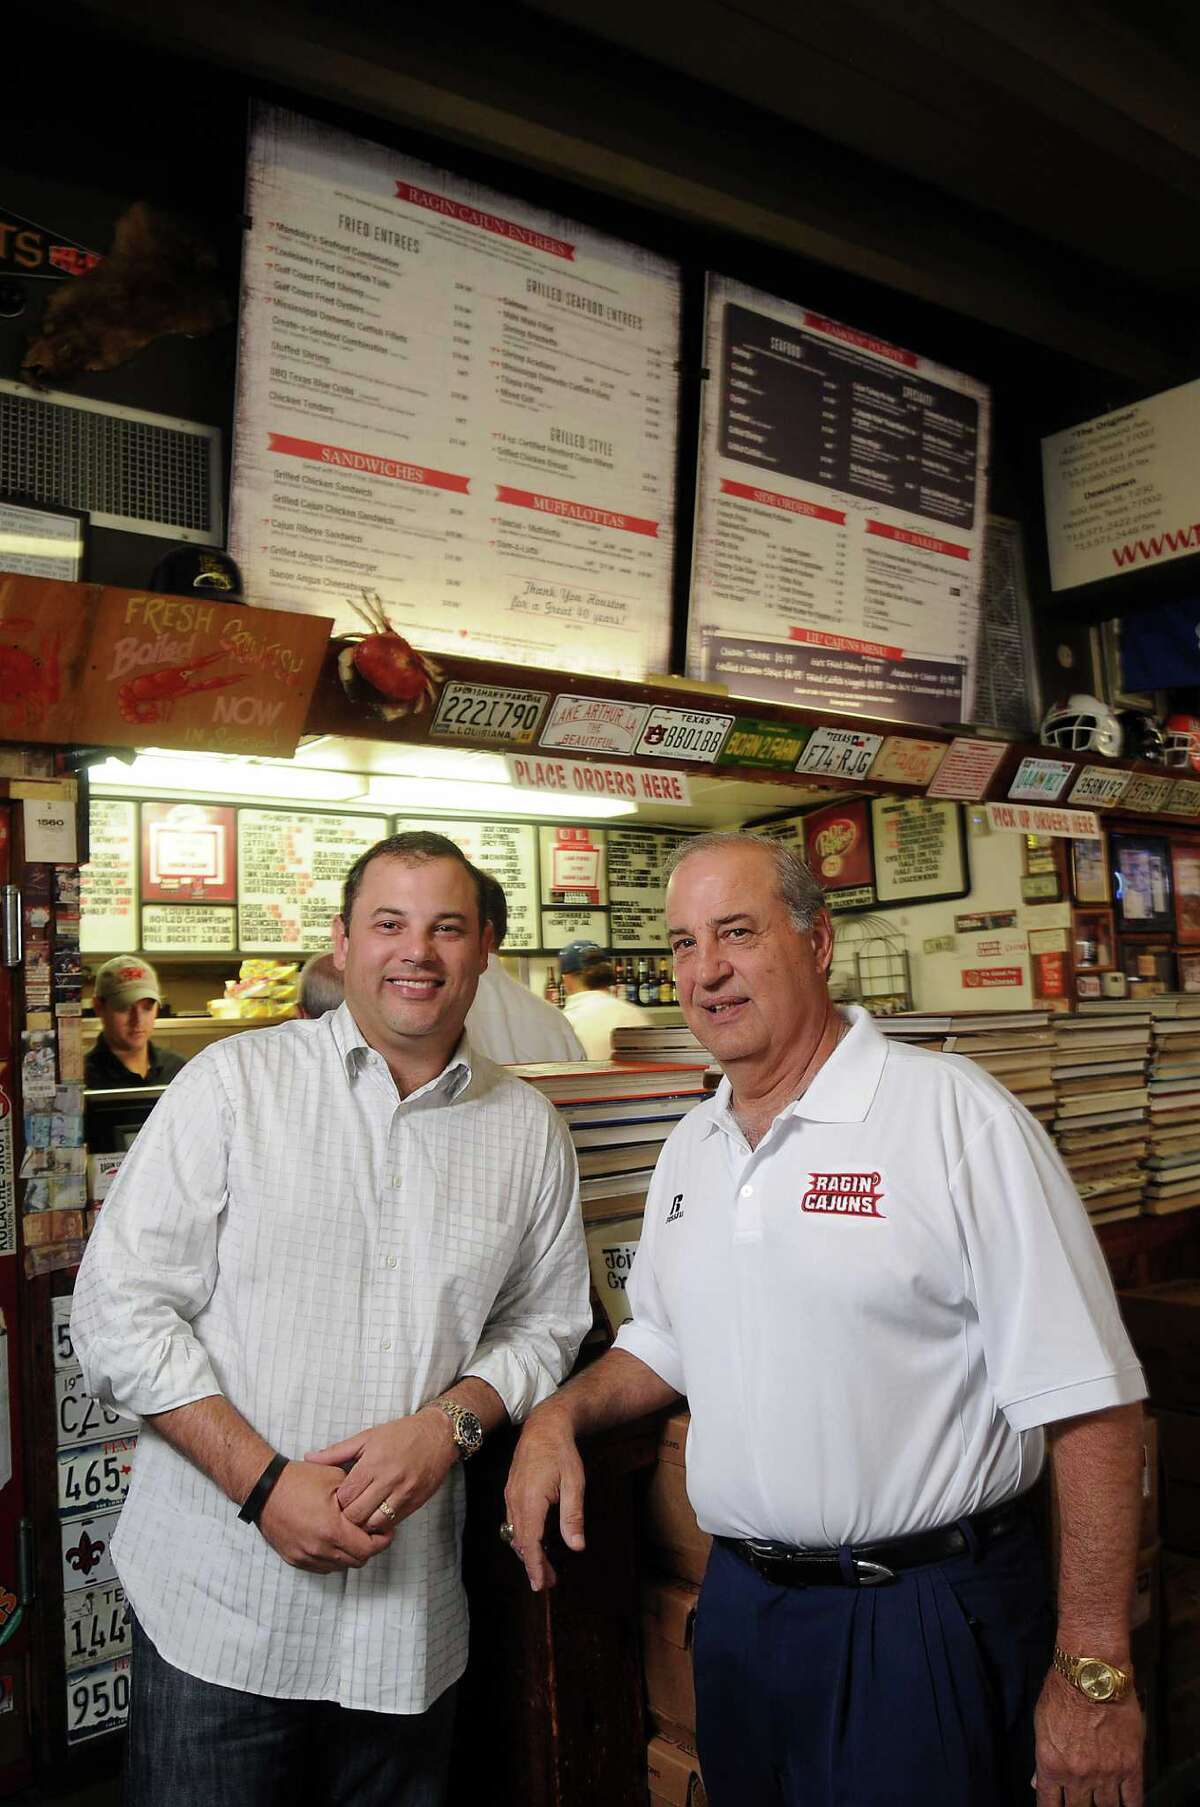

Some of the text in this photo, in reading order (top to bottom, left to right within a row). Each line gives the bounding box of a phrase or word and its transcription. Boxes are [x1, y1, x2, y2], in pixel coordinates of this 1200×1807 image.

[338, 214, 421, 254] FRIED ENTREES
[408, 188, 565, 254] RAGIN CAJUN ENTREES
[315, 258, 336, 272] Fried
[315, 276, 336, 289] Fried
[315, 294, 336, 306] Fried
[526, 277, 643, 331] GRILLED SEAFOOD ENTREES
[289, 371, 312, 386] Texas
[269, 391, 302, 406] Chicken
[549, 426, 614, 457] GRILLED STYLE
[321, 447, 425, 483] SANDWICHES
[273, 468, 374, 497] Grilled Chicken Sandwich
[272, 493, 396, 525] Grilled Cajun Chicken Sandwich
[533, 496, 626, 528] MUFFALOTTAS
[270, 518, 363, 544] Cajun Ribeye Sandwich
[269, 545, 378, 572] Grilled Angus Cheeseburger
[268, 568, 376, 594] Bacon Angus Cheeseburger
[524, 580, 555, 597] Thank
[124, 598, 215, 634] FRESH
[544, 601, 573, 617] Great
[106, 632, 197, 681] Boiled
[211, 695, 284, 726] NOW
[585, 703, 625, 723] ARTHUR
[680, 714, 713, 726] TEXAS
[456, 727, 512, 740] LOUISIANA
[560, 734, 617, 750] BEAUTIFUL
[829, 731, 851, 743] TEXAS
[514, 757, 683, 801] PLACE ORDERS HERE
[991, 806, 1096, 835] PICK UP ORDERS HERE
[816, 1172, 881, 1193] RAGIN'
[805, 1193, 874, 1213] CAJUNS
[602, 1247, 636, 1270] Joi
[64, 1377, 76, 1392] 19
[103, 1439, 137, 1456] TEXA
[65, 1456, 121, 1500] 465
[70, 1608, 126, 1657] 144
[72, 1674, 130, 1725] 950
